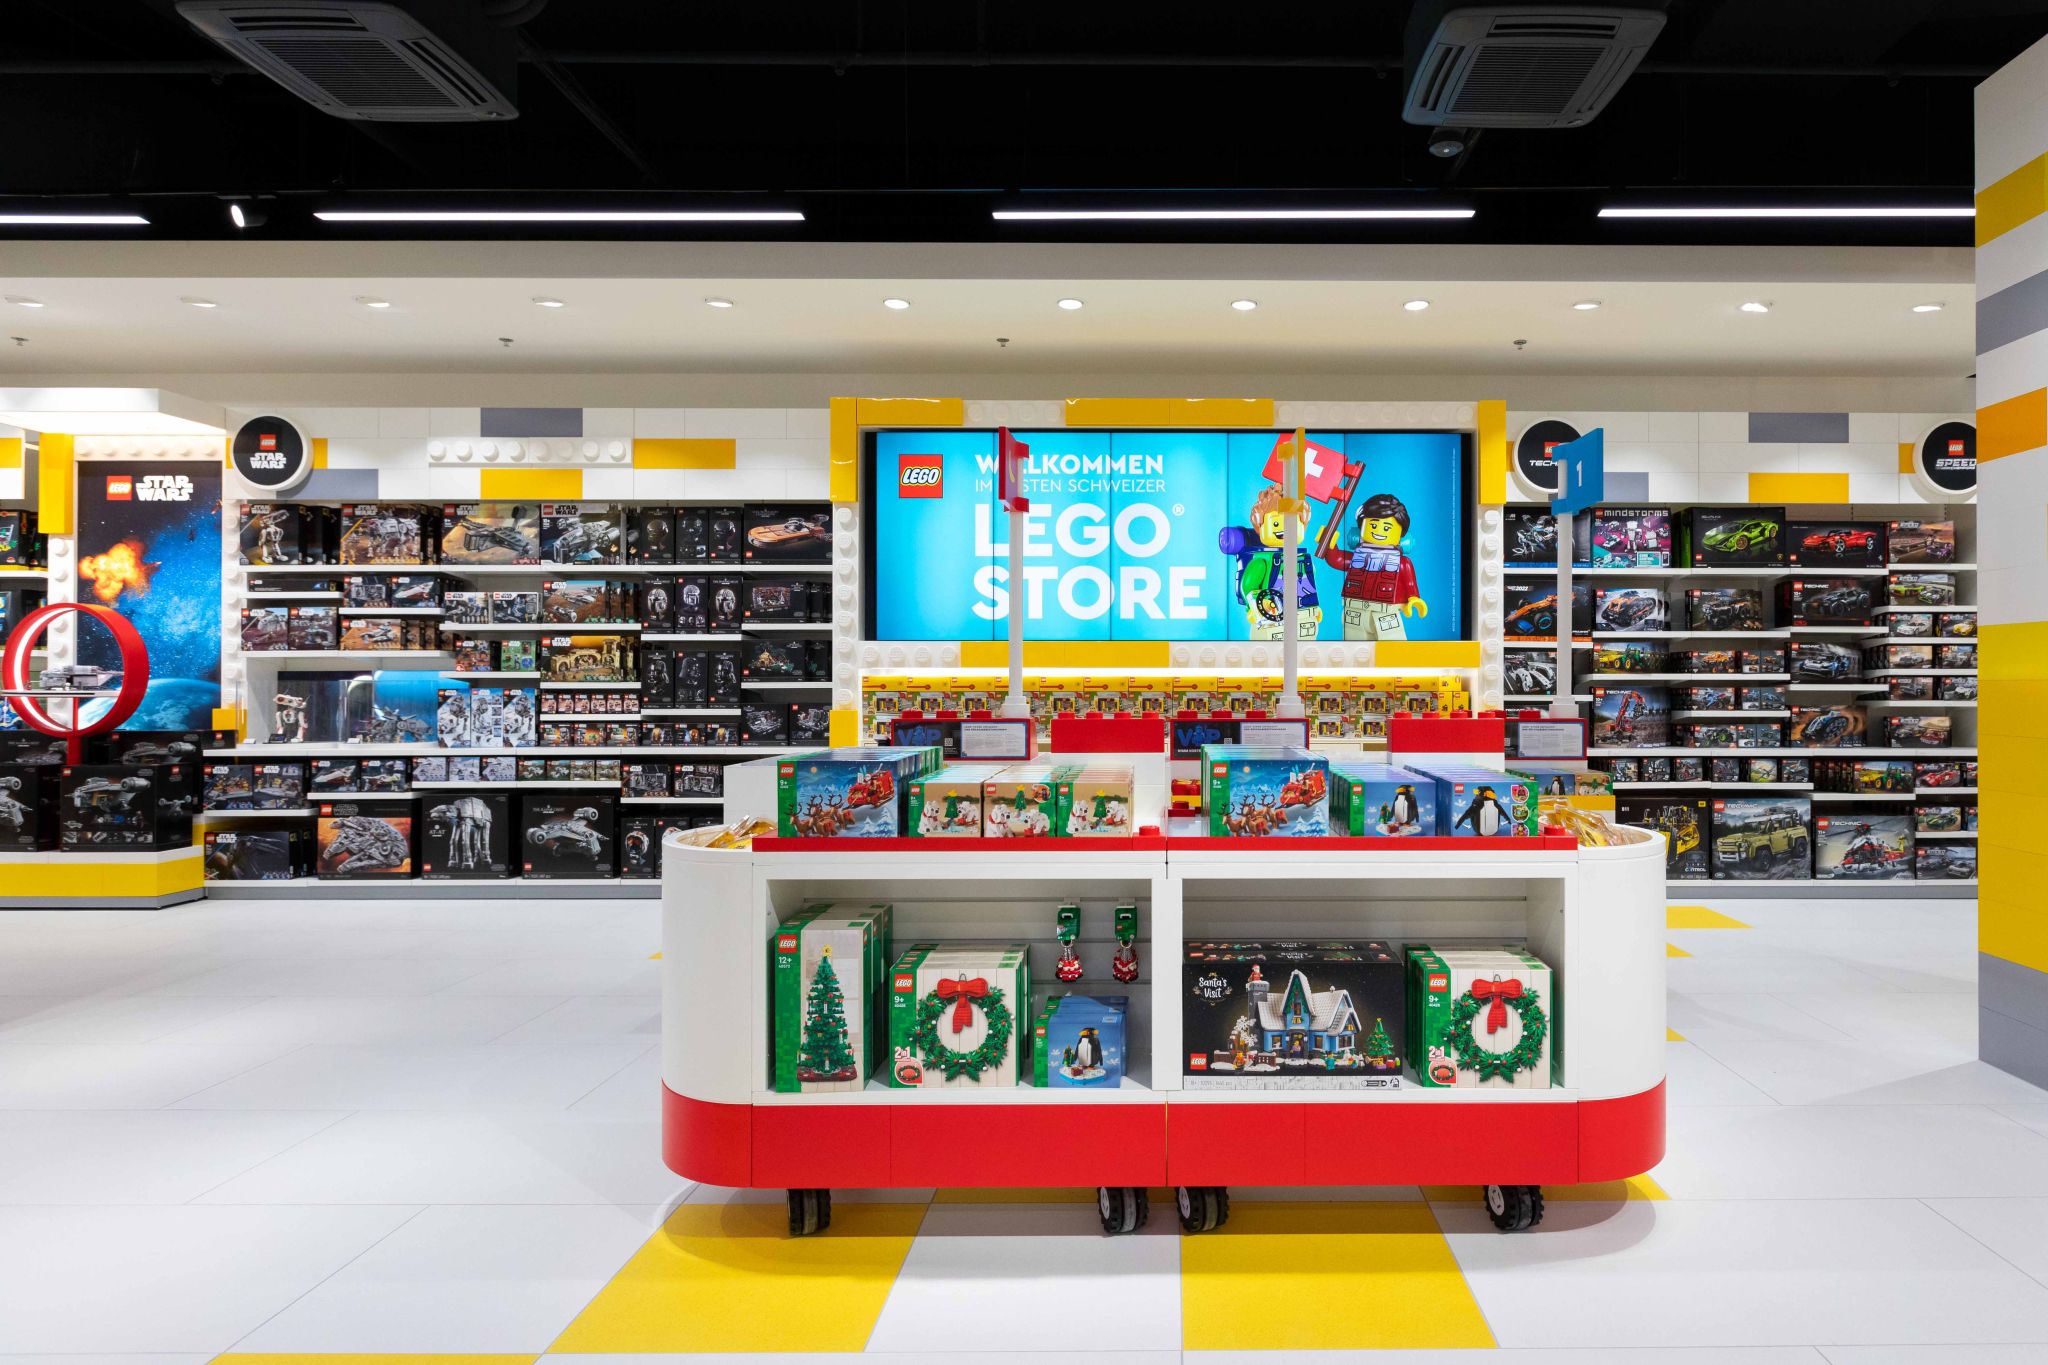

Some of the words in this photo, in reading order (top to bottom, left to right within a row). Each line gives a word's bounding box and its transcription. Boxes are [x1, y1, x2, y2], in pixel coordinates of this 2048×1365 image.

[250, 452, 286, 460] STAR
[250, 460, 286, 468] WARS
[975, 454, 1163, 475] WLKOMMEN
[901, 468, 941, 485] LEGO
[1576, 460, 1582, 487] 1
[136, 475, 193, 488] STAR
[975, 479, 993, 492] IM
[1068, 479, 1166, 492] SCHWEIZER
[136, 488, 193, 501] WARS
[971, 565, 1207, 620] STORE
[1199, 977, 1227, 987] Santa's
[1204, 988, 1222, 998] Visit
